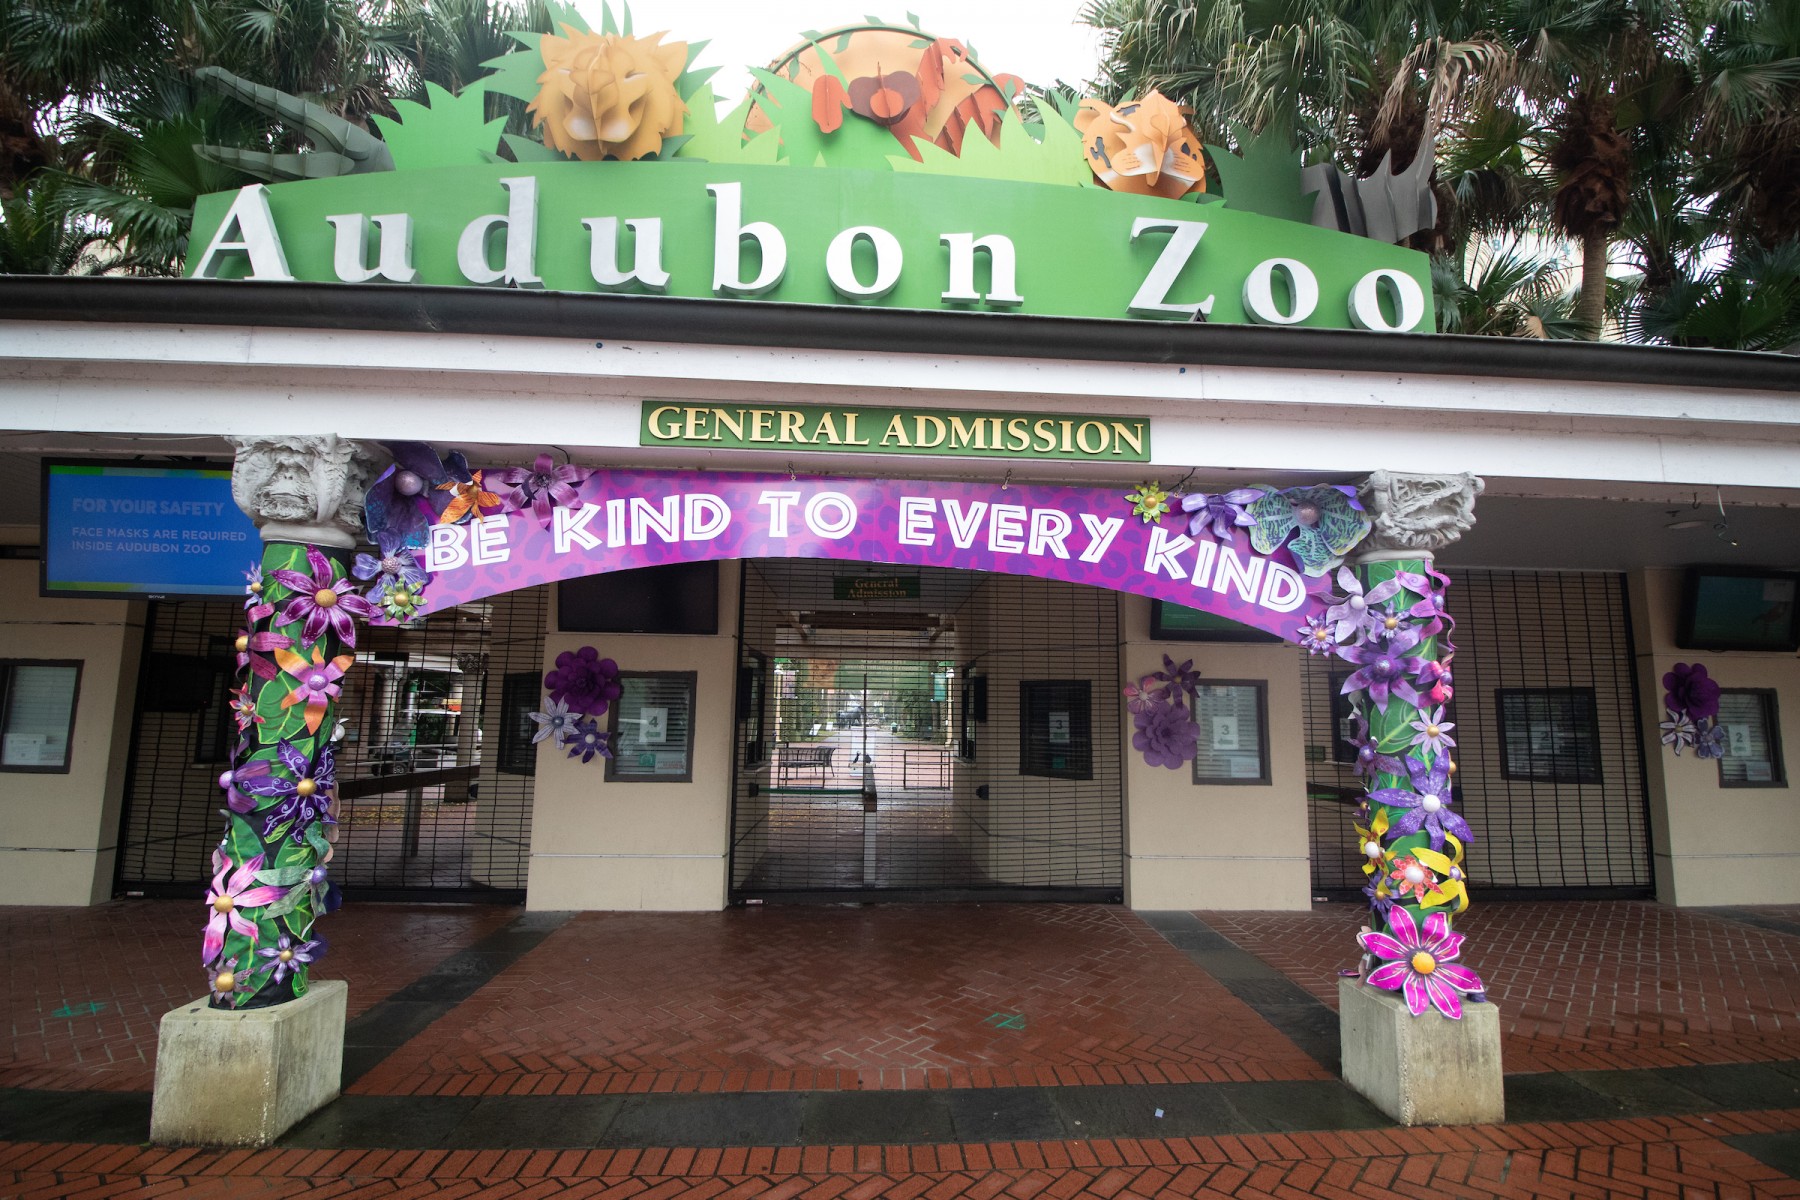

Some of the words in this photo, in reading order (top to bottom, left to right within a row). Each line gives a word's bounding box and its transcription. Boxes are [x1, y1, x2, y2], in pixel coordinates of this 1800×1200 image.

[190, 176, 1024, 306] Audubon
[1126, 216, 1425, 334] Zoo
[648, 406, 870, 446] GENERAL
[879, 414, 1144, 455] ADMISSION
[72, 498, 107, 513] FOR
[110, 500, 157, 515] YOUR
[159, 501, 225, 516] SAFETY
[72, 527, 103, 537] FACE
[107, 528, 149, 538] MASKS
[153, 530, 178, 539] ARE
[182, 530, 247, 541] REQUIRED
[72, 541, 113, 551] INSIDE
[116, 542, 180, 553] AUDUBON
[183, 544, 211, 554] ZOO
[425, 514, 510, 572] BE
[553, 493, 732, 554] KIND
[758, 491, 858, 540] TO
[898, 496, 1124, 564] EVERY
[1143, 526, 1307, 613] KIND
[855, 578, 899, 588] General
[848, 588, 907, 598] Admission
[648, 716, 659, 728] 4
[1055, 720, 1063, 730] 3
[1221, 724, 1230, 735] 3
[1735, 732, 1743, 743] 2
